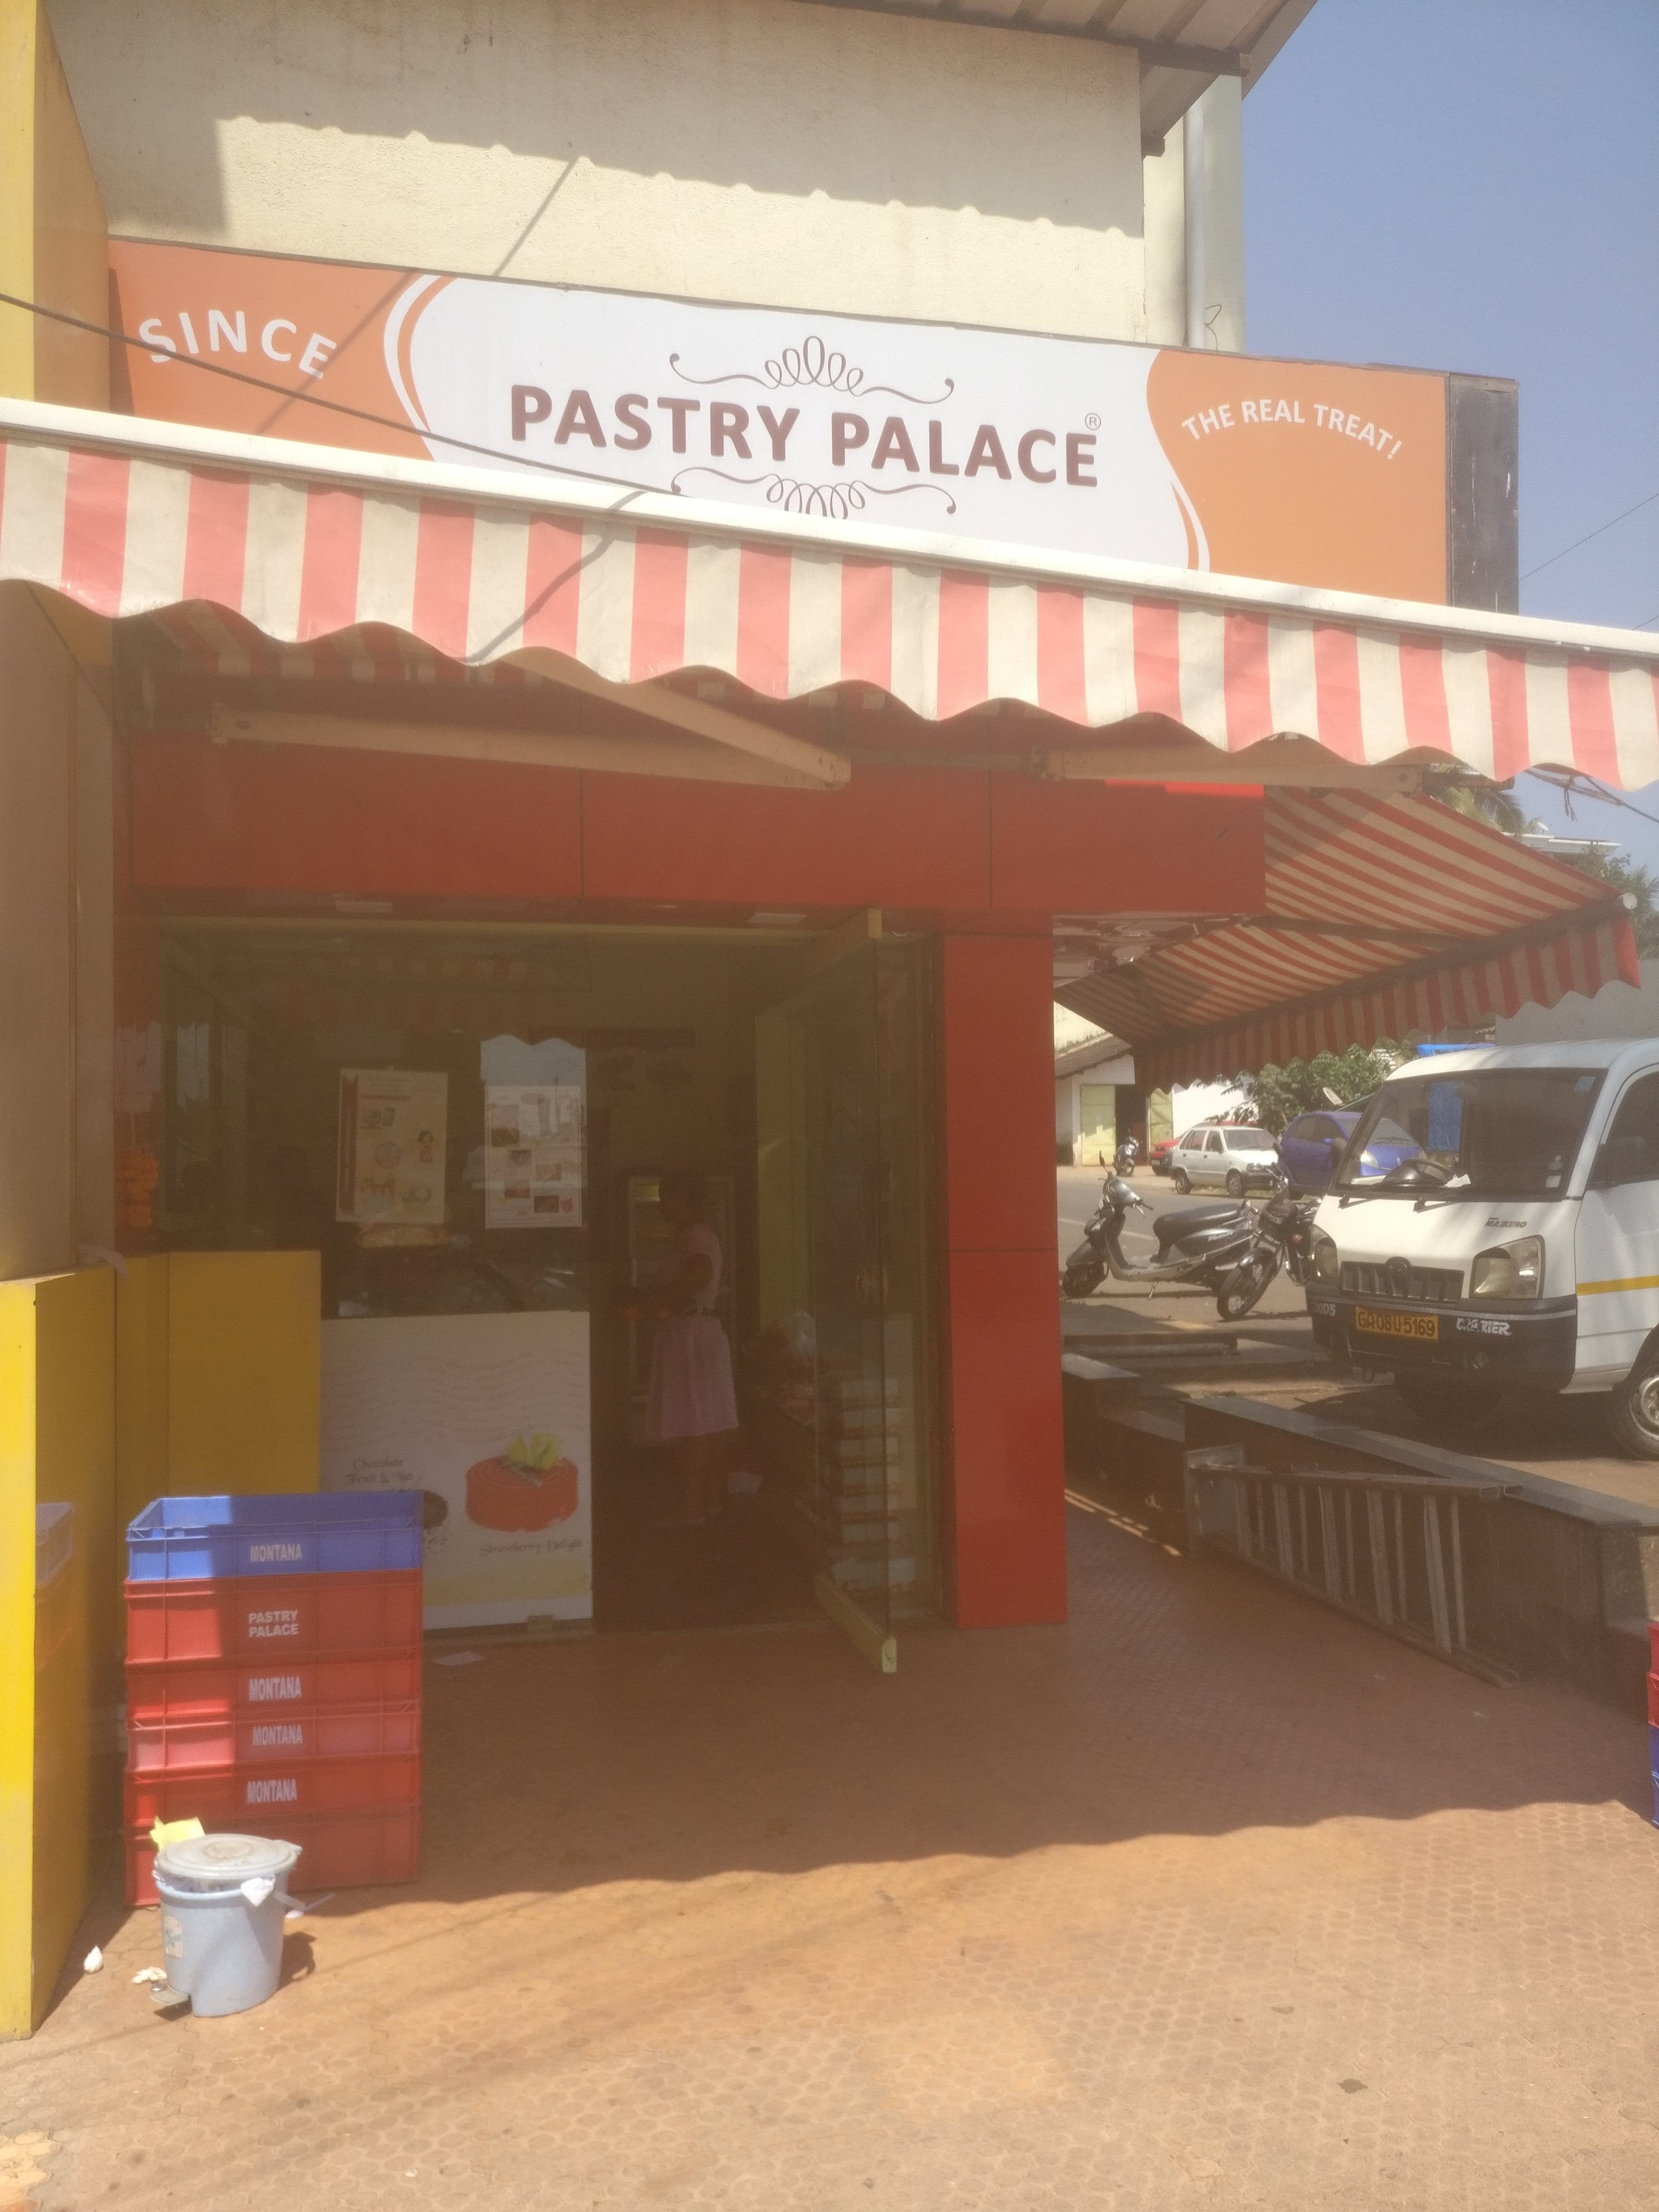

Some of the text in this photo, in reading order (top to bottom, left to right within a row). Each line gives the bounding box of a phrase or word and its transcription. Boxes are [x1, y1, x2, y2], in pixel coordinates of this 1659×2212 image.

[139, 309, 338, 379] SINCE
[511, 385, 800, 462] PASTRY
[831, 411, 1098, 488] PALACE
[1182, 399, 1402, 460] THE REAL TREAT!
[250, 1543, 302, 1563] MONTANA
[248, 1609, 298, 1624] PASTRY
[249, 1623, 299, 1638] PALACE
[248, 1676, 302, 1701] MONTANA
[252, 1724, 303, 1746] MONTANA
[246, 1779, 298, 1804] MONTANA
